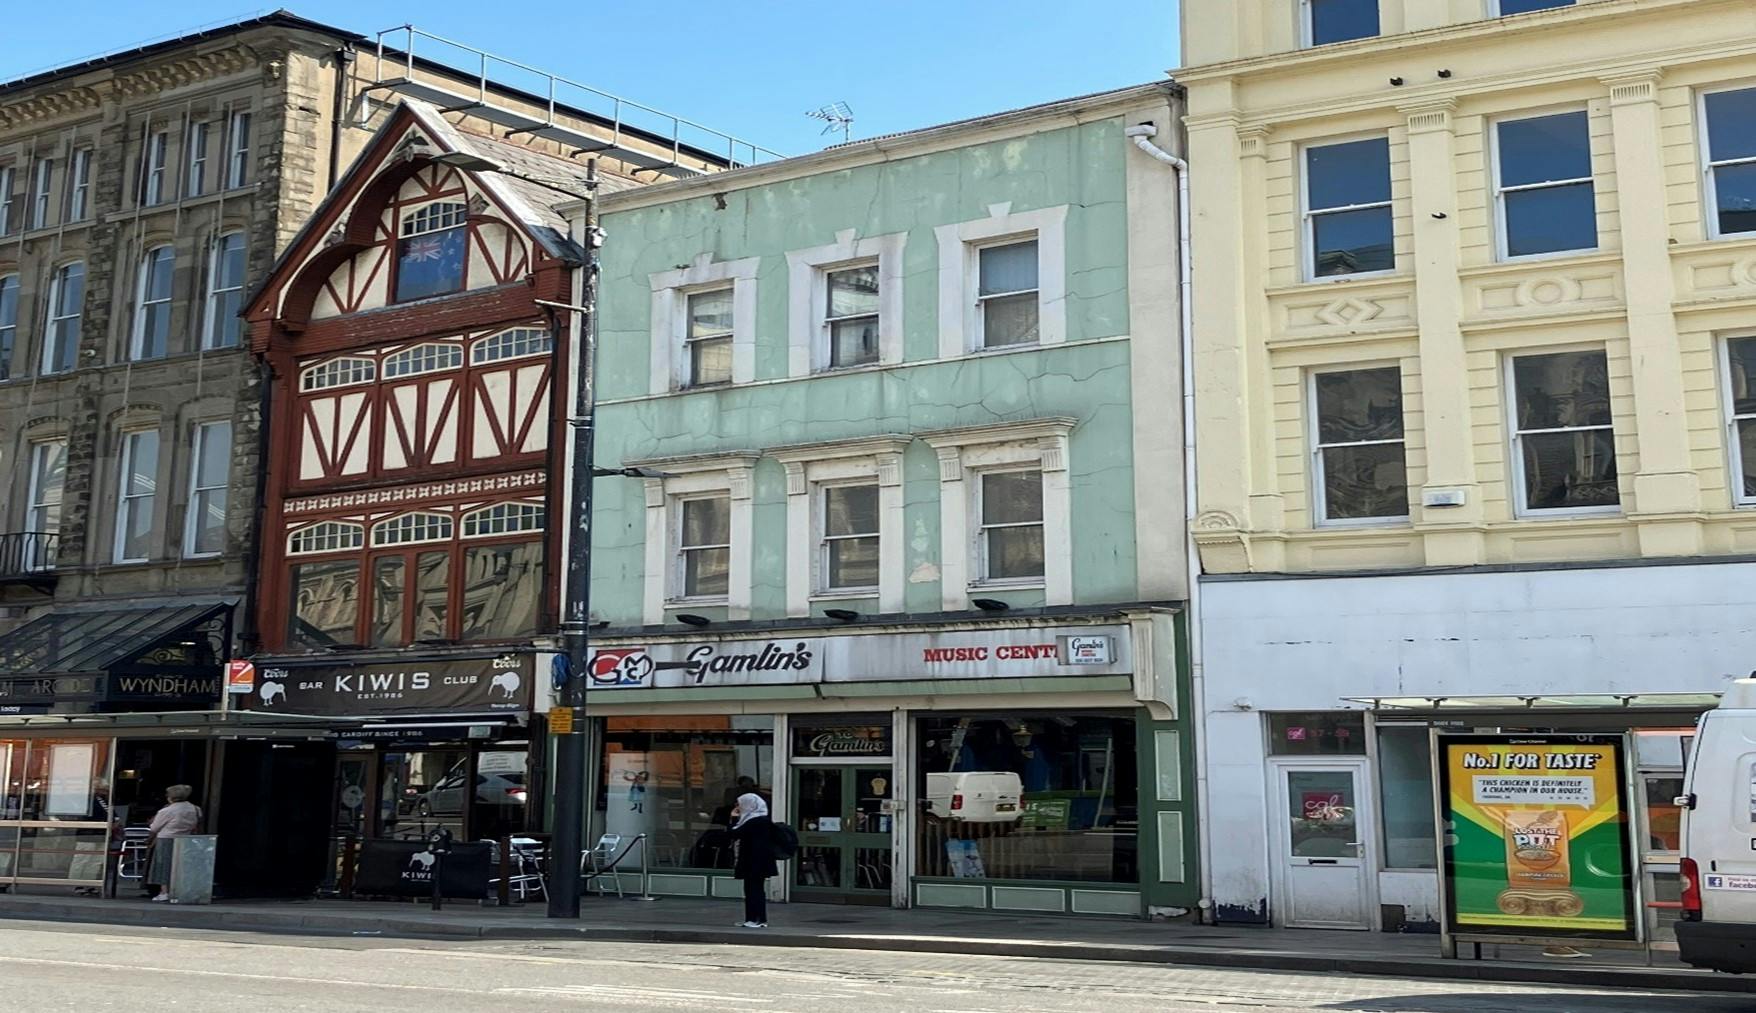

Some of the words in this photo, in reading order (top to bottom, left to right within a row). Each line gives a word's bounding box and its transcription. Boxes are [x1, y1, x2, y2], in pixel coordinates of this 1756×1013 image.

[924, 647, 988, 662] MUSIC
[686, 642, 812, 684] Gamlin's
[120, 678, 215, 693] WYNDHAM
[299, 682, 323, 690] BAR
[335, 672, 430, 692] KIWIS
[443, 676, 478, 685] CLUB
[1463, 753, 1499, 769] No.1
[1504, 753, 1540, 769] FOR
